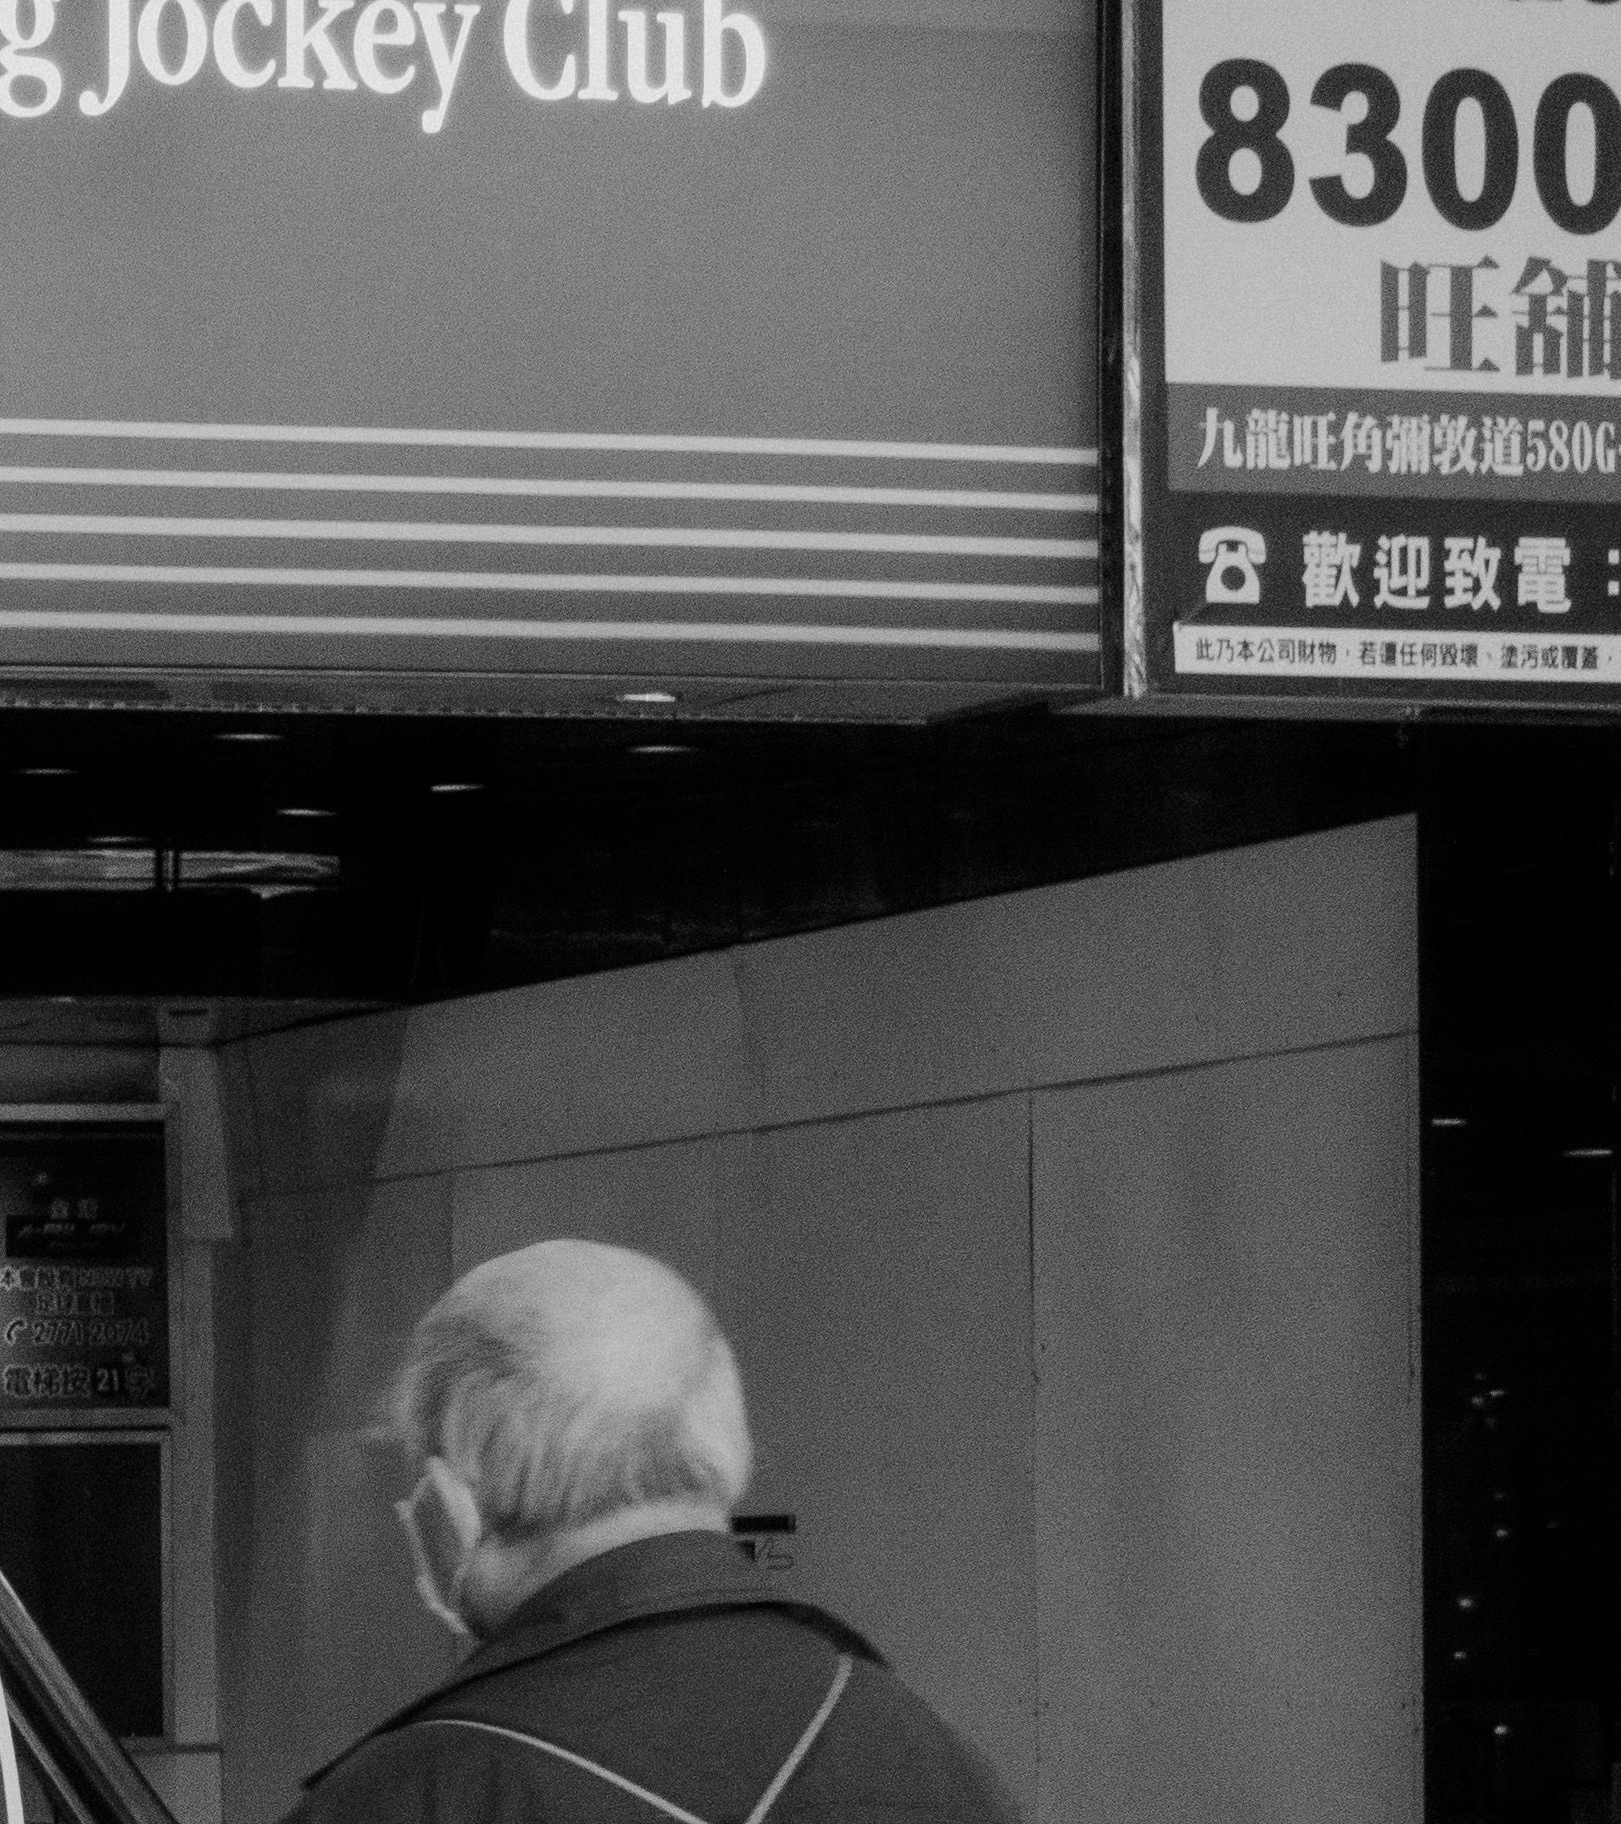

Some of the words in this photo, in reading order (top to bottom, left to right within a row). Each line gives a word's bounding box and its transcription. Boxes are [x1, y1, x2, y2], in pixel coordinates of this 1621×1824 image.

[79, 0, 481, 134] Jockey
[503, 0, 766, 108] Club
[1195, 58, 1621, 235] 8300
